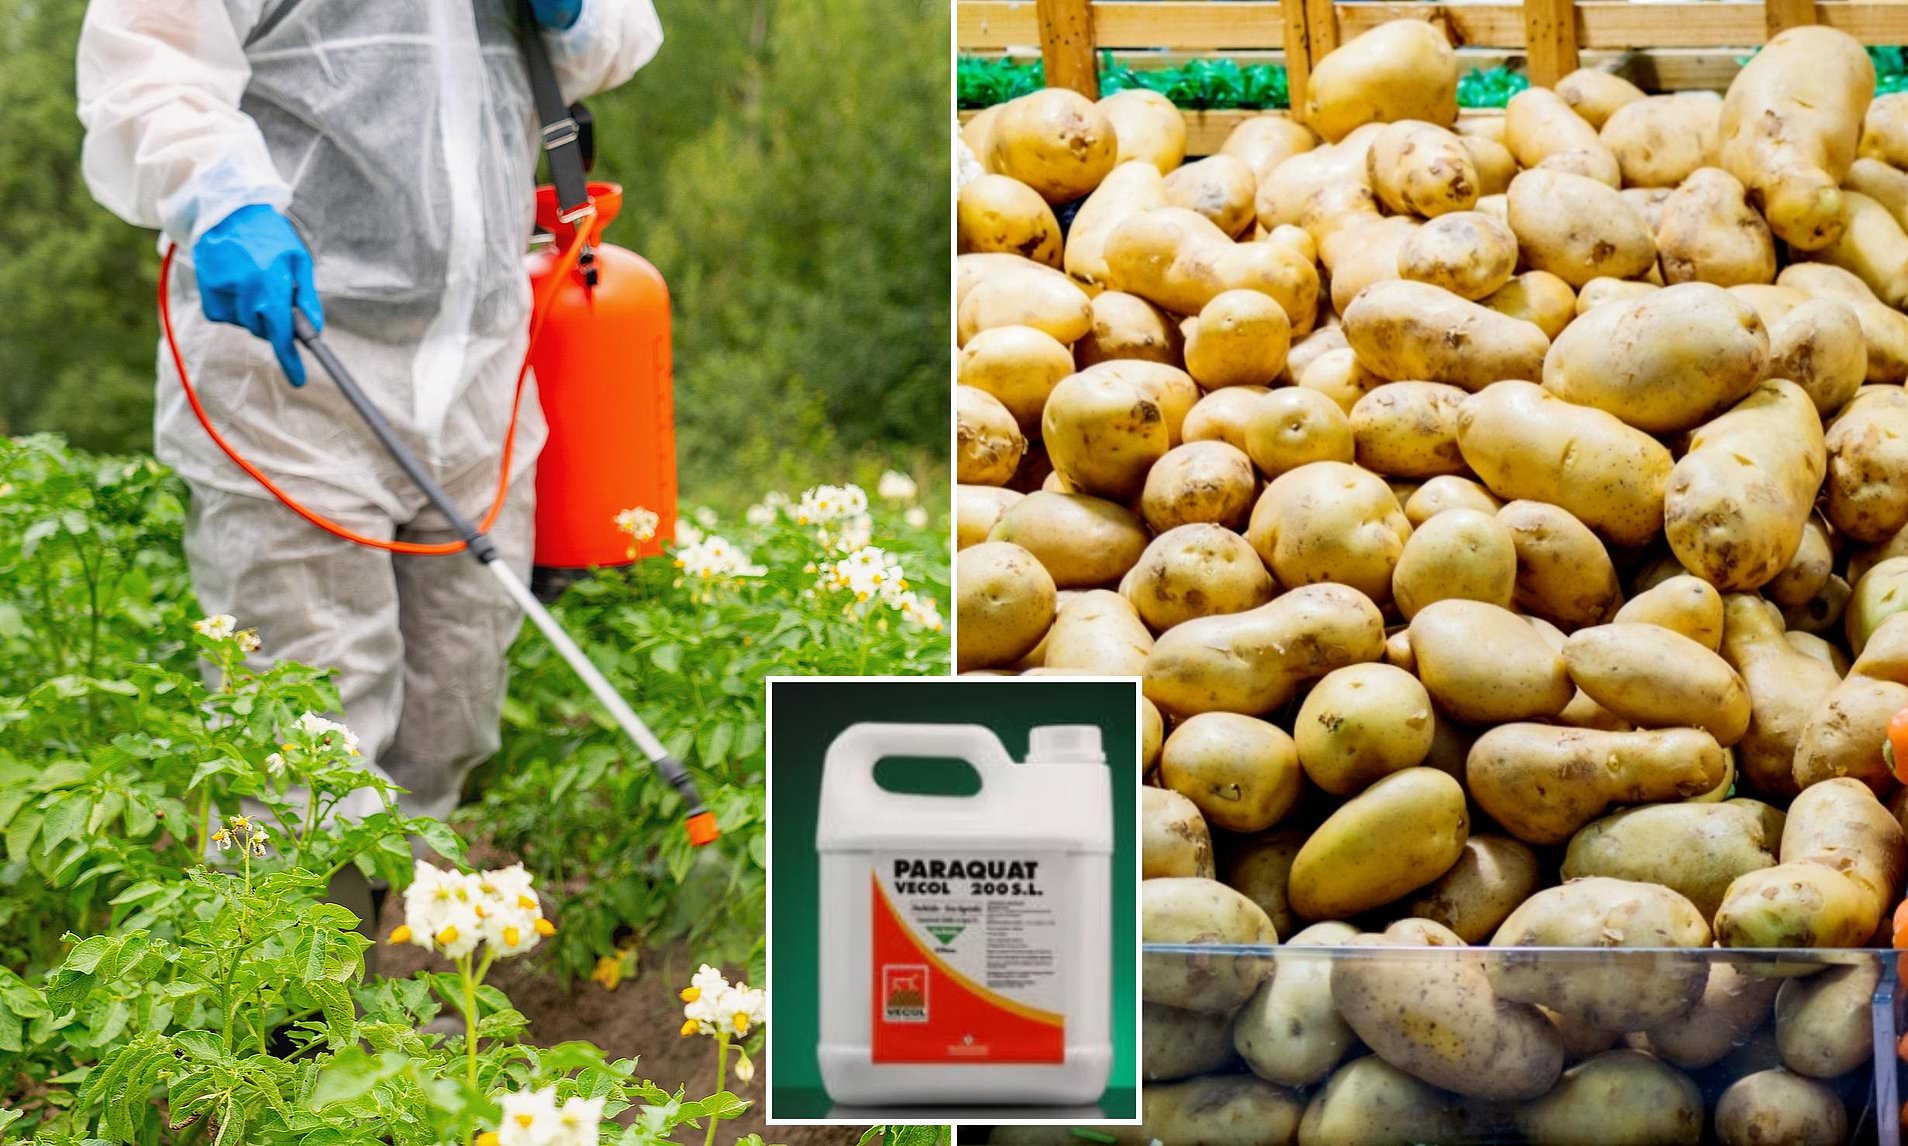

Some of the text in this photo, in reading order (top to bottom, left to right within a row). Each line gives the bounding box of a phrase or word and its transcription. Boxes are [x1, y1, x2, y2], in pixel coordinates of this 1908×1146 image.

[894, 859, 1038, 880] PARAQUAT
[895, 881, 950, 895] VECOL
[887, 1007, 926, 1017] VECOL
